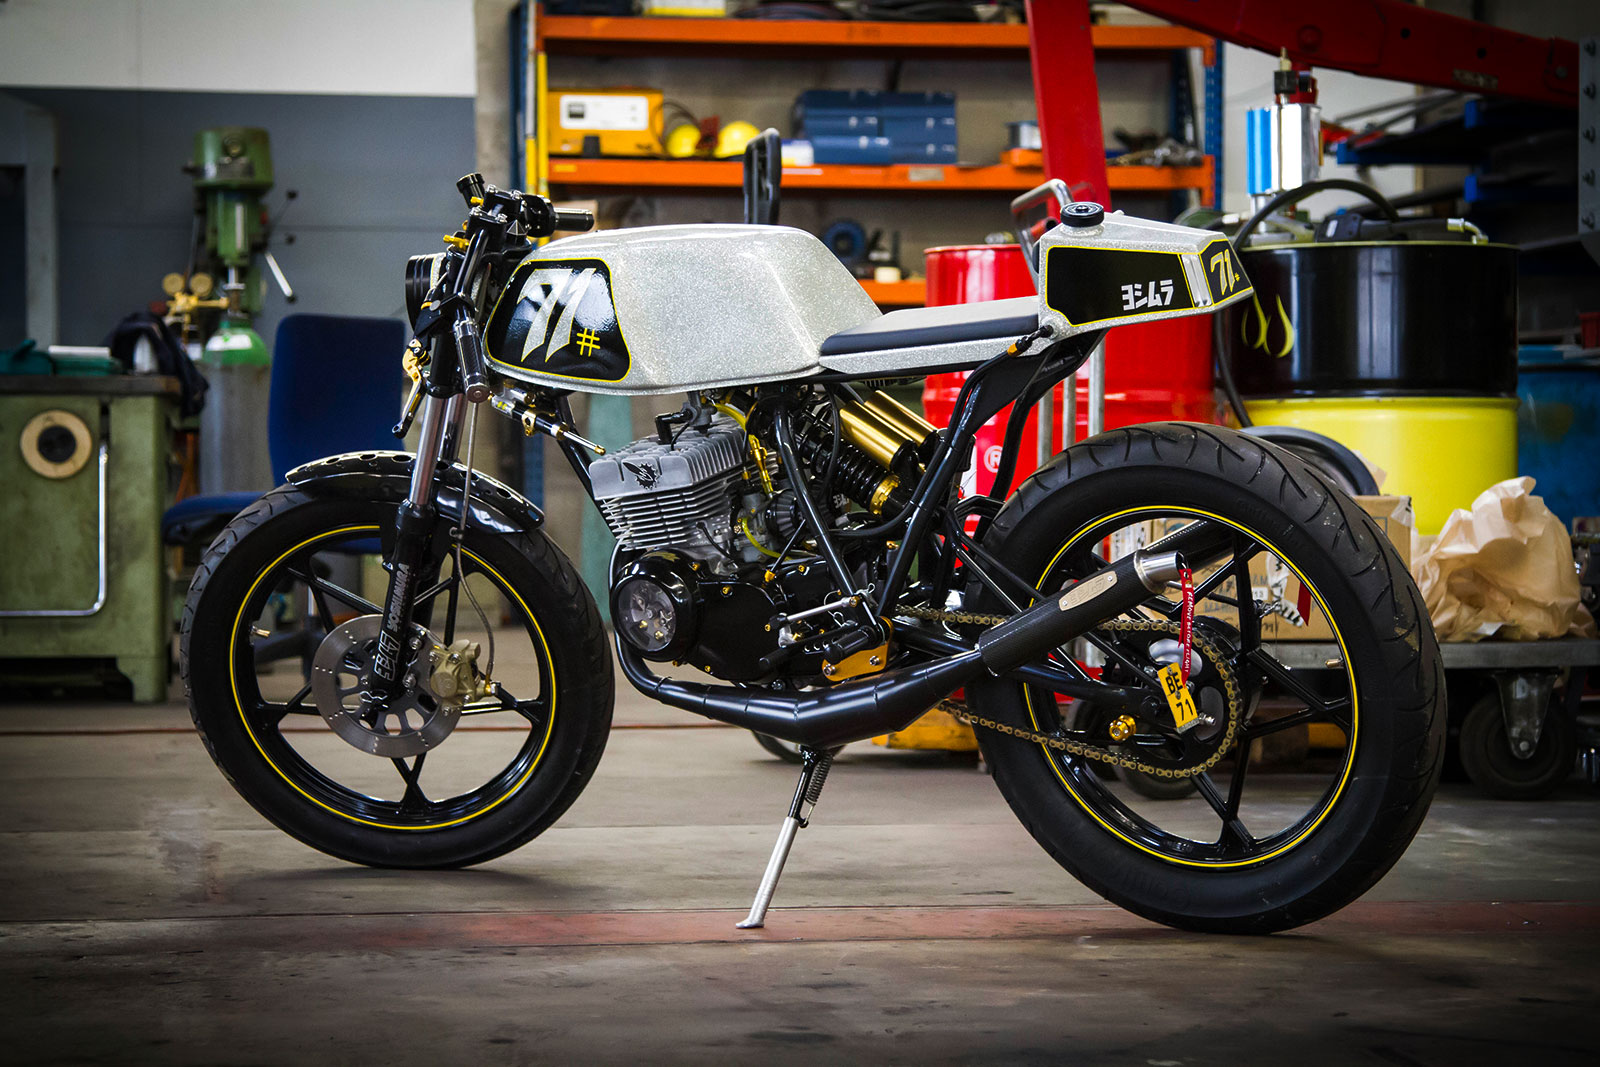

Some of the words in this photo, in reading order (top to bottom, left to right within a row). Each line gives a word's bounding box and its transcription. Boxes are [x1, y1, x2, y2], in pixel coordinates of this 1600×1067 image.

[1210, 248, 1235, 296] 71
[1121, 279, 1174, 311] ヨシムラ
[516, 268, 597, 362] 71
[387, 563, 409, 632] YOSHIMURA
[1186, 591, 1194, 620] REMOVE
[1165, 671, 1184, 695] BE
[1176, 698, 1194, 721] 71
